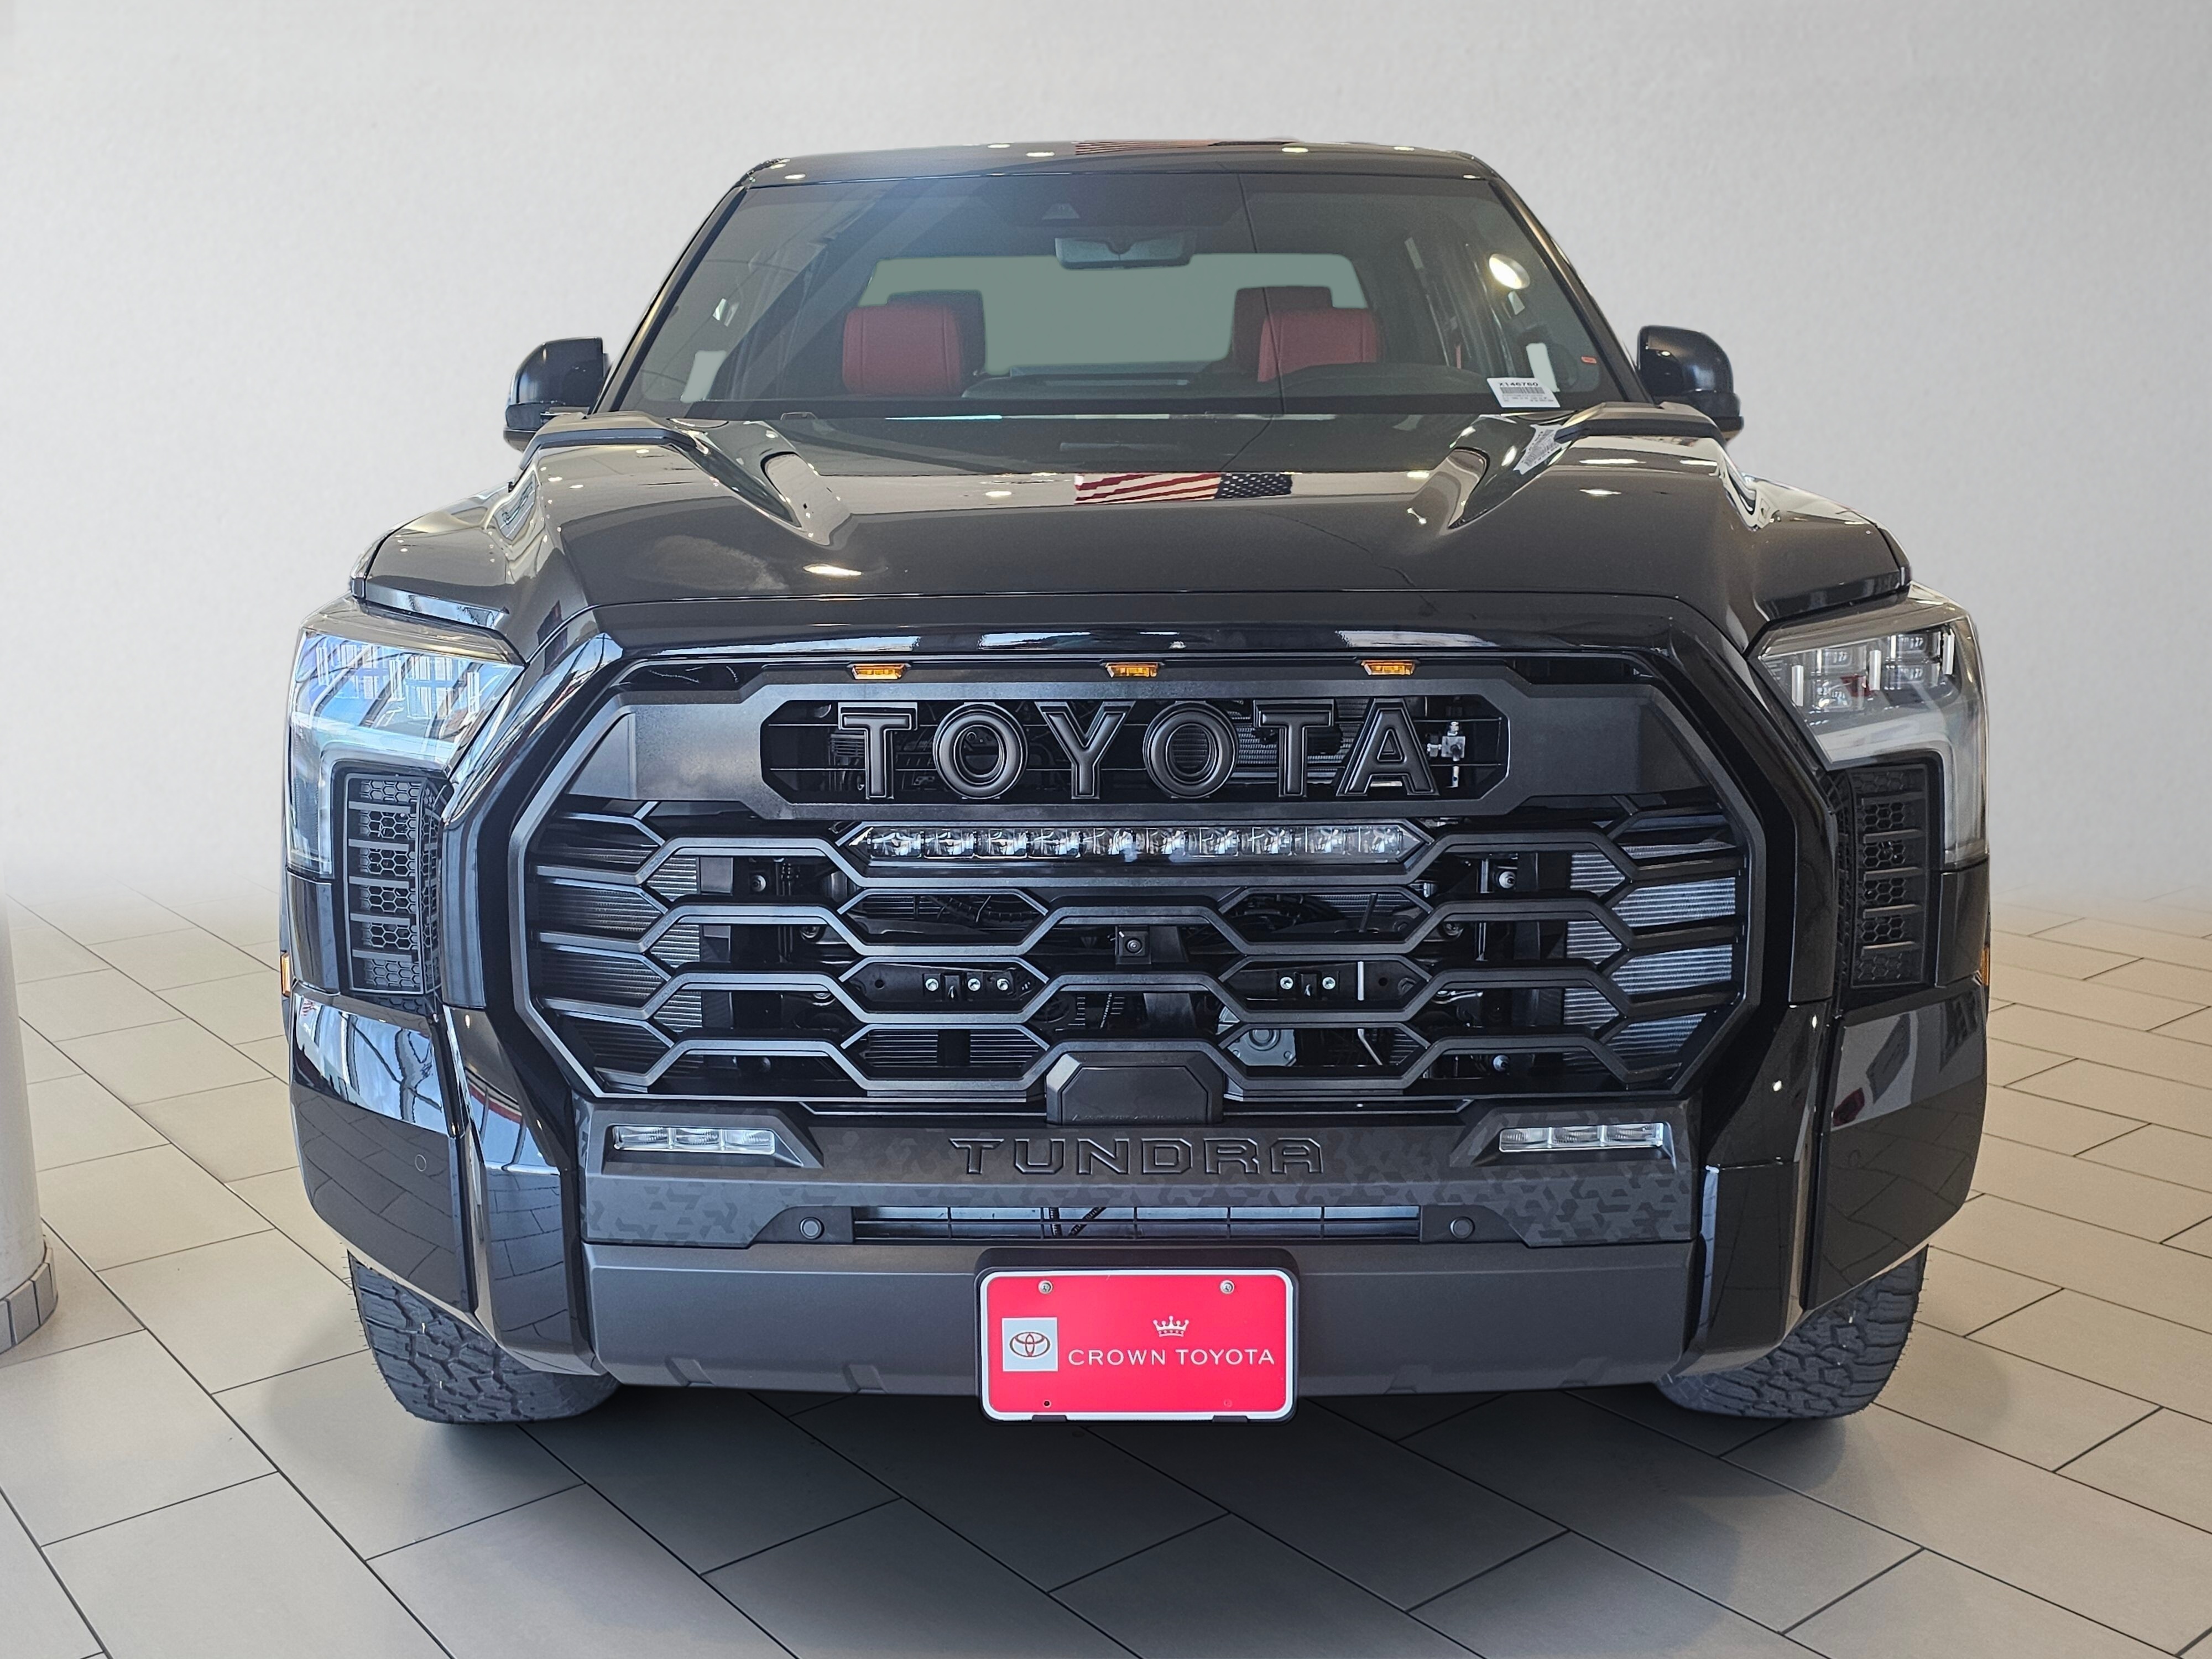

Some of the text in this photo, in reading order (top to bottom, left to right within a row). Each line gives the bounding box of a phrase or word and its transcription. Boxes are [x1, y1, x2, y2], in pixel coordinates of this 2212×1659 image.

[838, 698, 1439, 800] TOYOTA
[949, 1138, 1323, 1175] TUNDRA
[1068, 1348, 1275, 1366] CROWN TOYOTA
